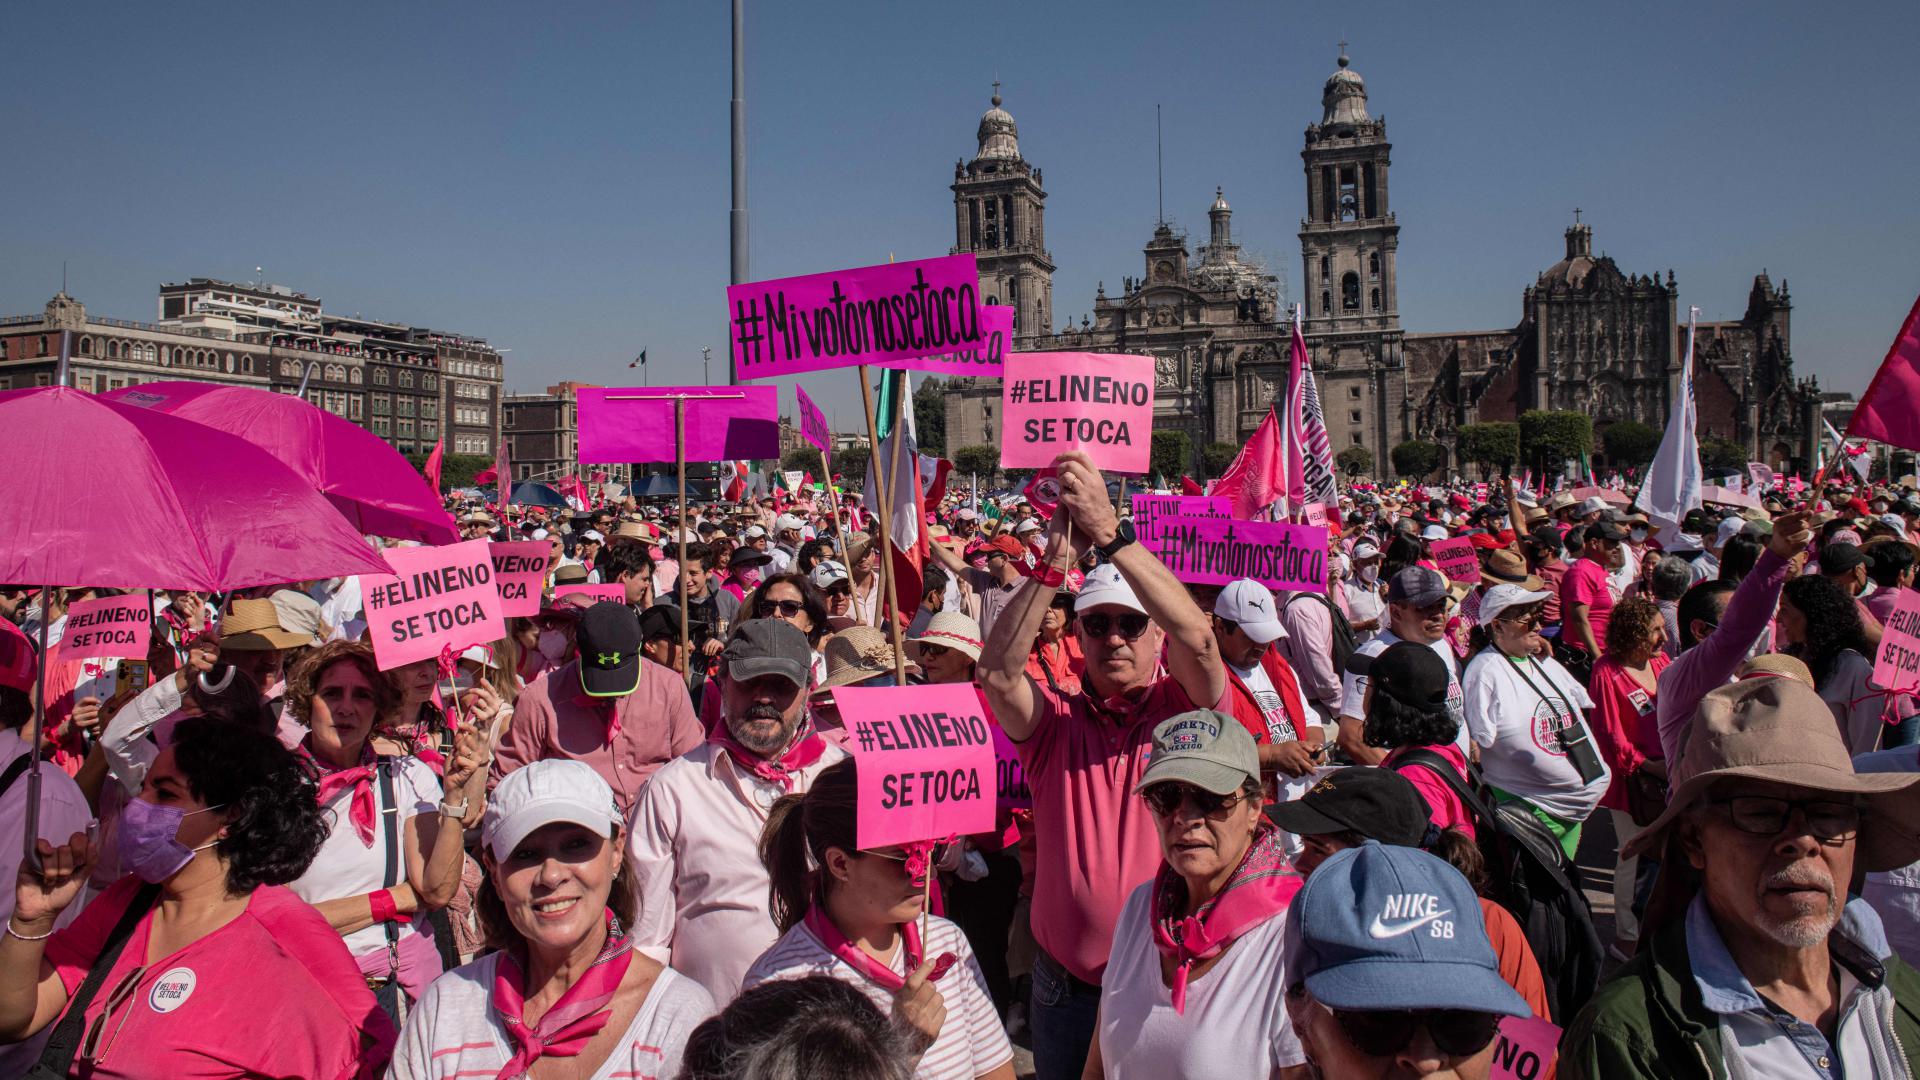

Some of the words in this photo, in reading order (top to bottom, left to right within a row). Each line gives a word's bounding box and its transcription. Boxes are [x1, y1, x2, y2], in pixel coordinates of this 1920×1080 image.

[735, 268, 980, 366] #Mivotonosetoca
[1010, 375, 1149, 407] #ELINENO
[1023, 418, 1057, 443] SE
[1063, 417, 1132, 446] TOCA
[1159, 525, 1323, 585] #Mivotonosetoca
[370, 563, 490, 610] #ELINENO
[69, 606, 149, 629] #ELINENO
[391, 615, 423, 643] SE
[424, 601, 487, 634] TOCA
[72, 633, 92, 648] SE
[95, 630, 137, 645] TOCA
[1883, 642, 1898, 665] SE
[856, 712, 988, 752] #ELINENO
[1161, 720, 1217, 739] LORETO
[881, 772, 914, 809] SE
[919, 767, 981, 804] TOCA
[1382, 893, 1439, 919] NIKE
[1430, 920, 1455, 939] SB
